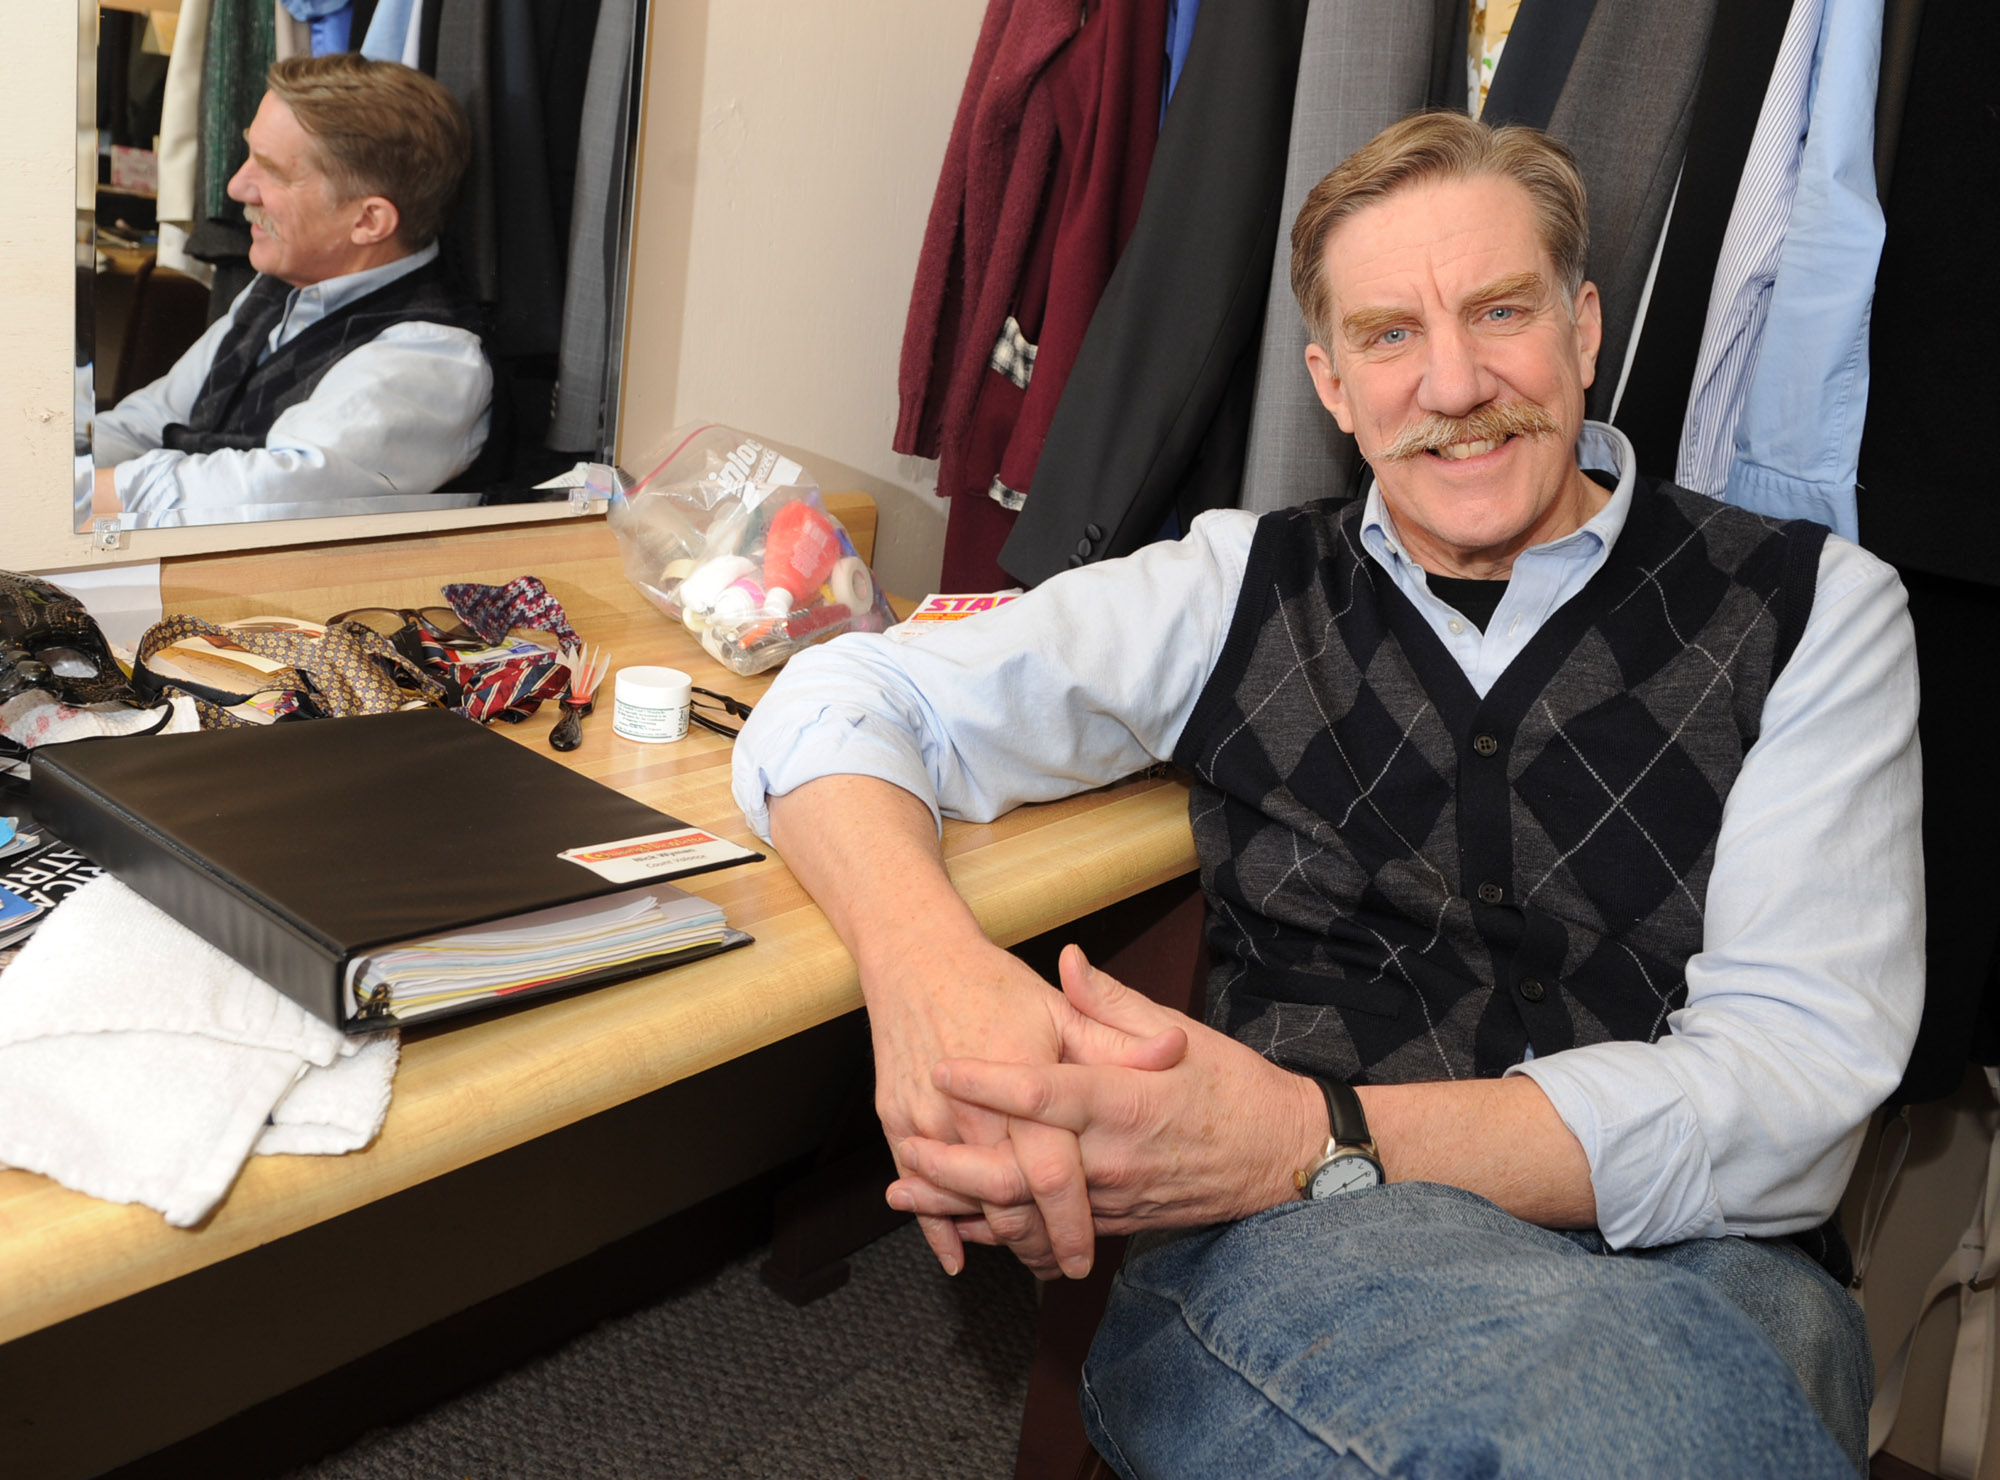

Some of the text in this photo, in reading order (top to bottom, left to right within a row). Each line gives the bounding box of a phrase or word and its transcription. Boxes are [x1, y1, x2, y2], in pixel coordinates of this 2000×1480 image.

[707, 438, 763, 492] iploc
[0, 849, 87, 896] ATRE
[633, 851, 658, 863] Nick
[28, 866, 102, 908] RICA
